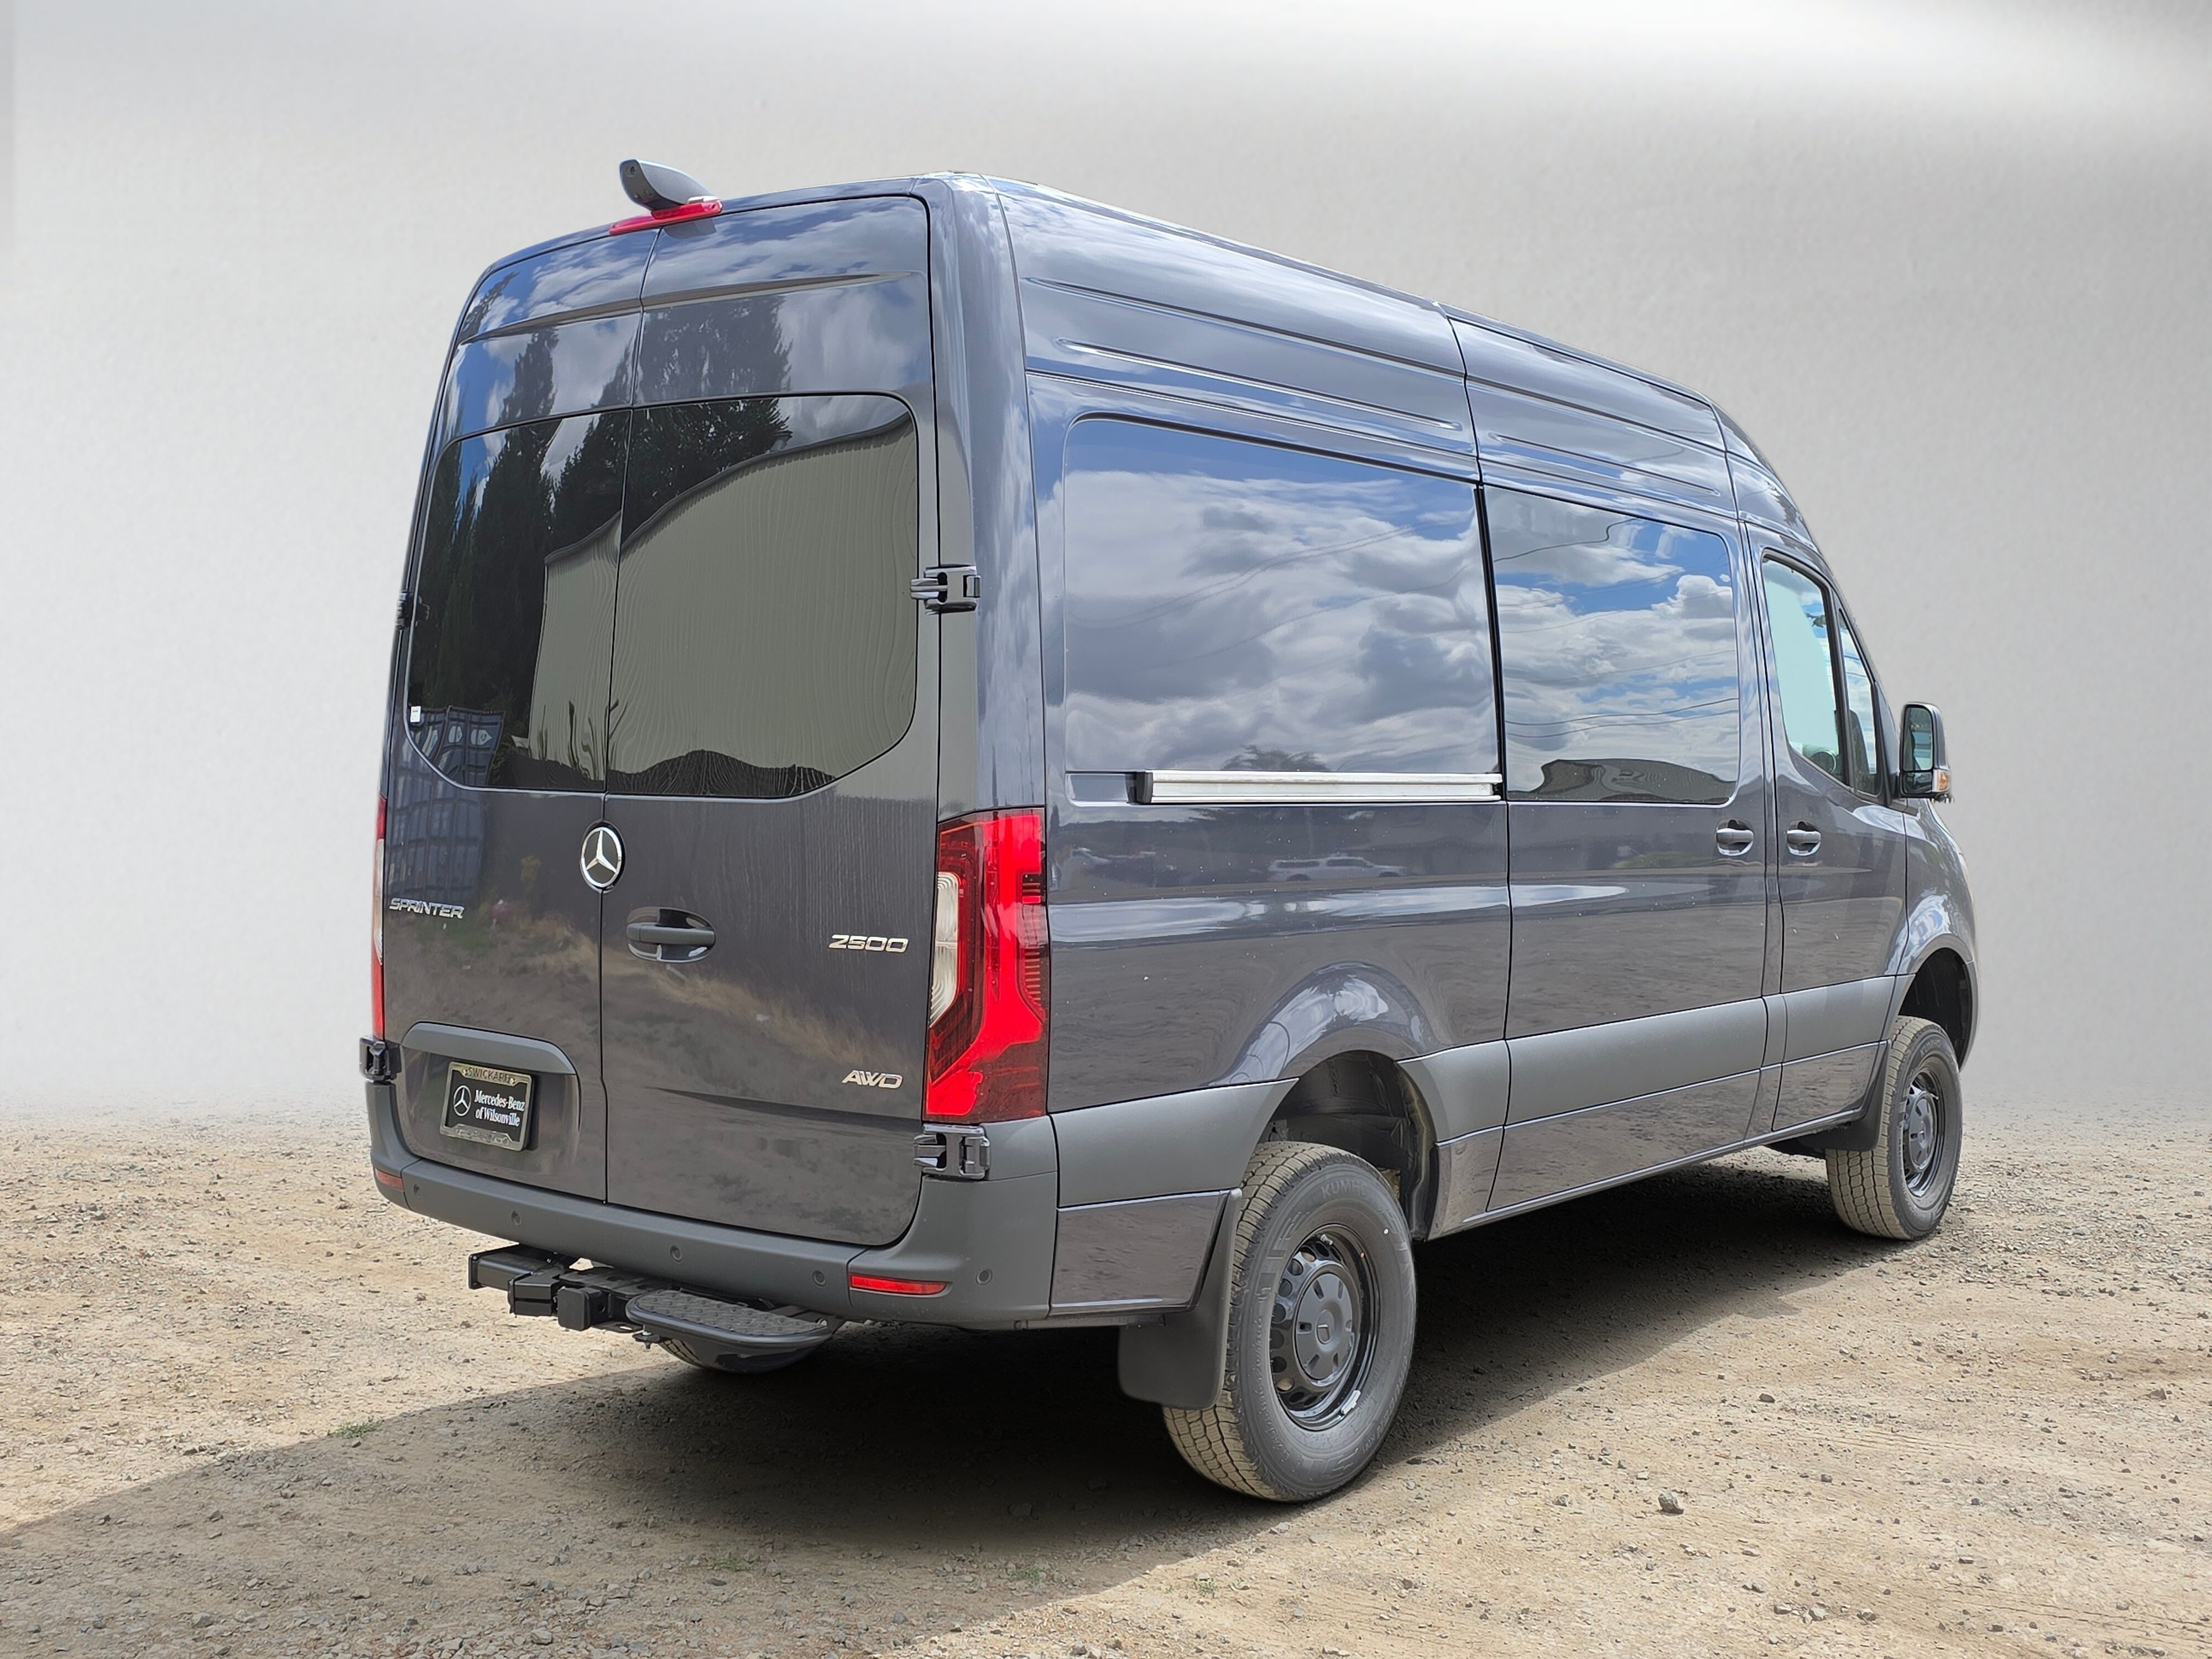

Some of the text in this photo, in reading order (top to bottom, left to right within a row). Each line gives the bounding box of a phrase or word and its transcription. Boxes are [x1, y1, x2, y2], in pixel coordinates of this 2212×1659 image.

[389, 898, 465, 919] SPRINTER
[829, 935, 909, 953] 2500
[842, 1070, 902, 1089] AWD
[474, 1089, 525, 1112] Mercedes-Benz
[476, 1107, 520, 1127] of Wilsonville
[1321, 1180, 1368, 1200] KUMHO
